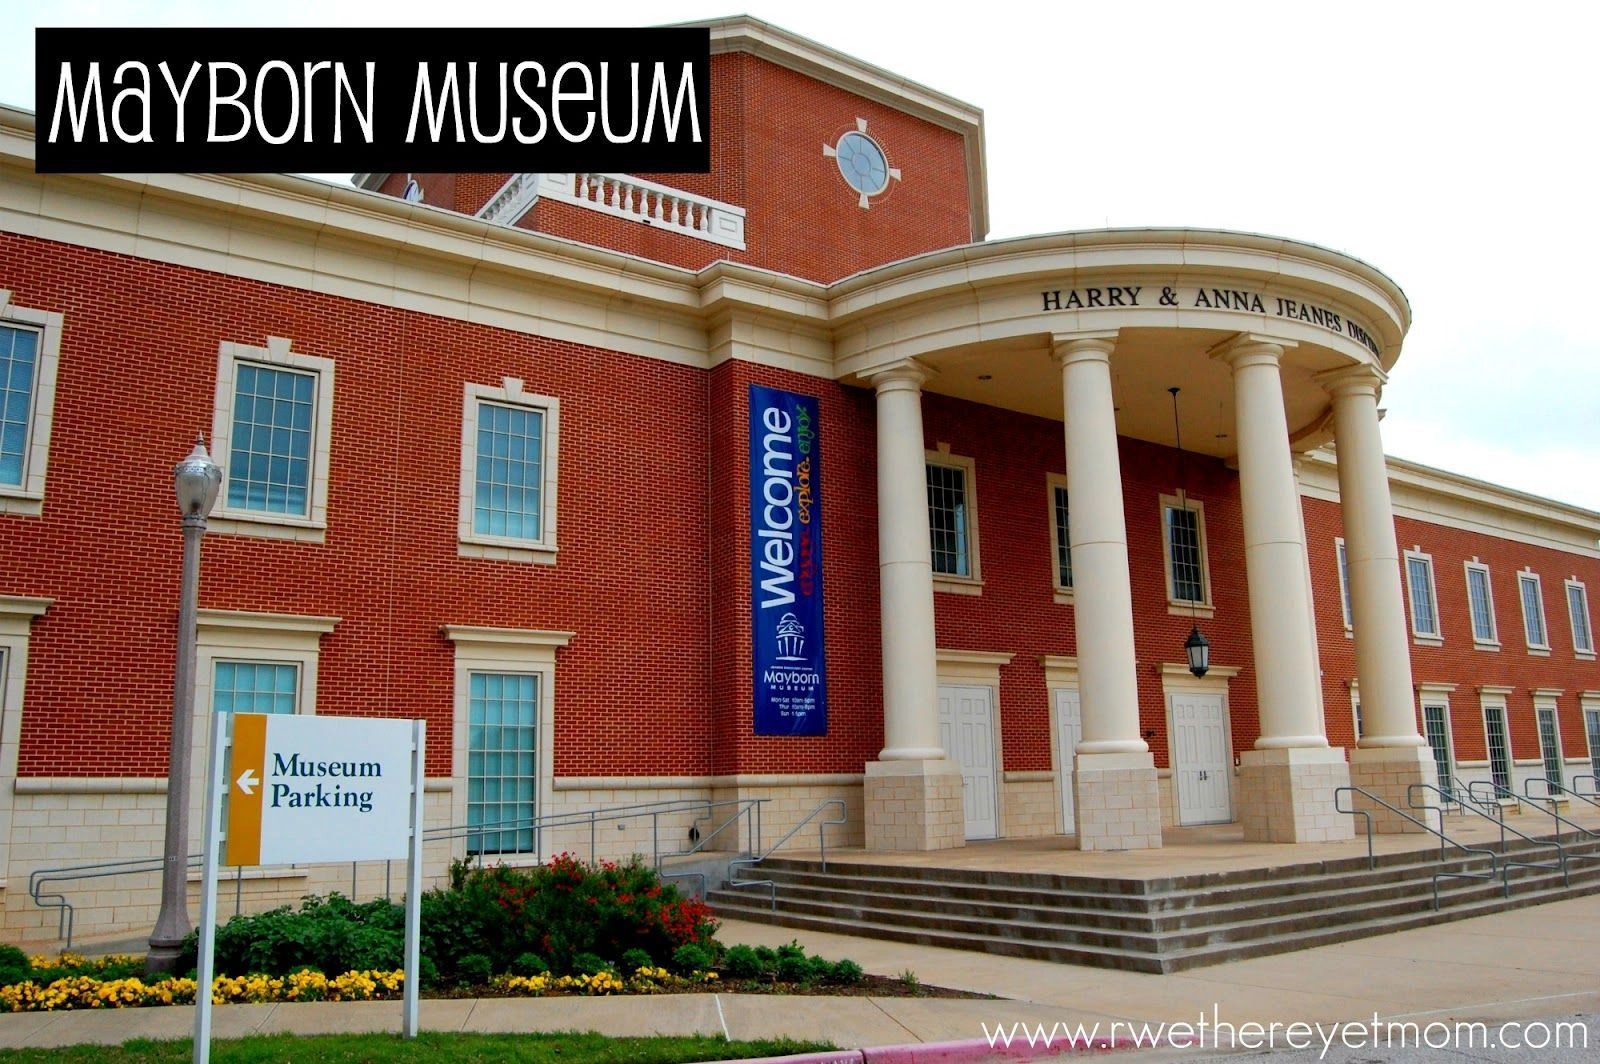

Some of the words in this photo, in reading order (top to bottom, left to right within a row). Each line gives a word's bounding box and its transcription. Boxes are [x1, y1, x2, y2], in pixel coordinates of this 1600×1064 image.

[1041, 286, 1143, 312] HARRY
[1158, 286, 1180, 307] &
[1194, 287, 1266, 314] ANNA
[1275, 297, 1343, 333] JEANES
[758, 407, 795, 608] Welcome
[763, 670, 820, 685] Mayborn
[271, 752, 383, 778] Museum
[271, 783, 374, 813] Parking
